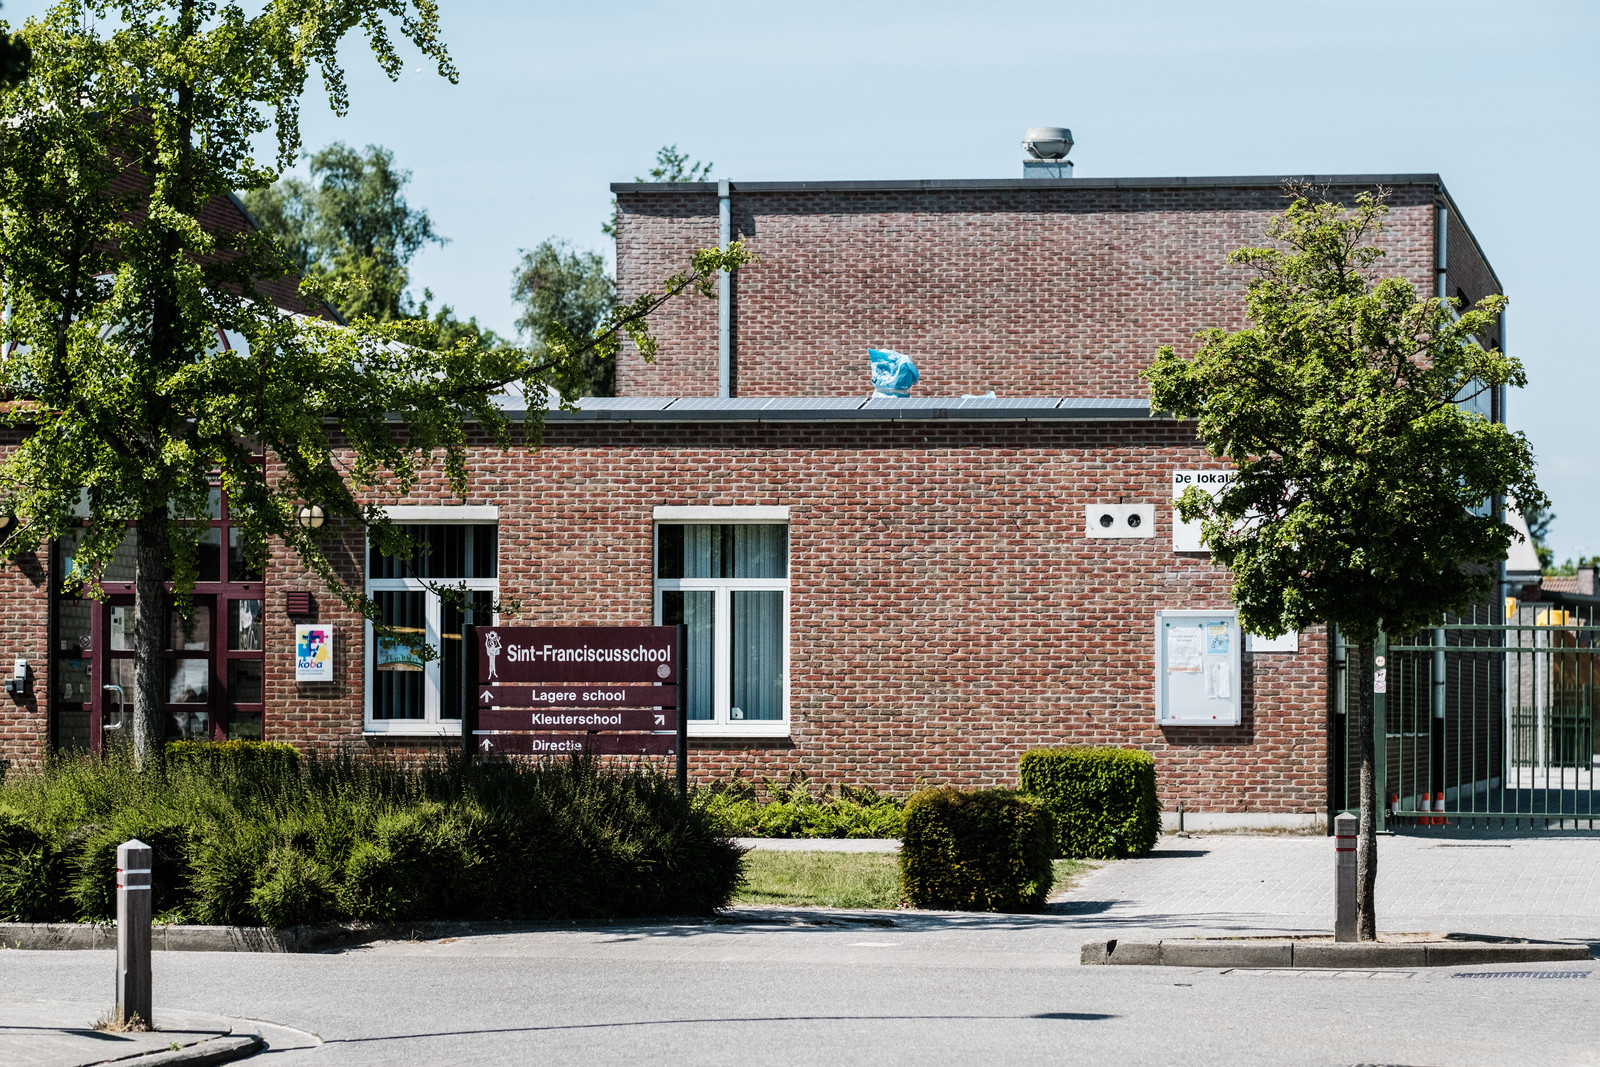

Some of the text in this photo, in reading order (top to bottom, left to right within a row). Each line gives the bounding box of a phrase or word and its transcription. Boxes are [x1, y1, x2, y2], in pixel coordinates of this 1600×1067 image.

[1175, 474, 1192, 484] De
[507, 644, 671, 662] Sint-Franciscusschool
[298, 659, 323, 669] koba
[532, 689, 626, 703] Lagere school
[532, 713, 622, 725] Kleuterschool
[532, 739, 583, 751] Directie
